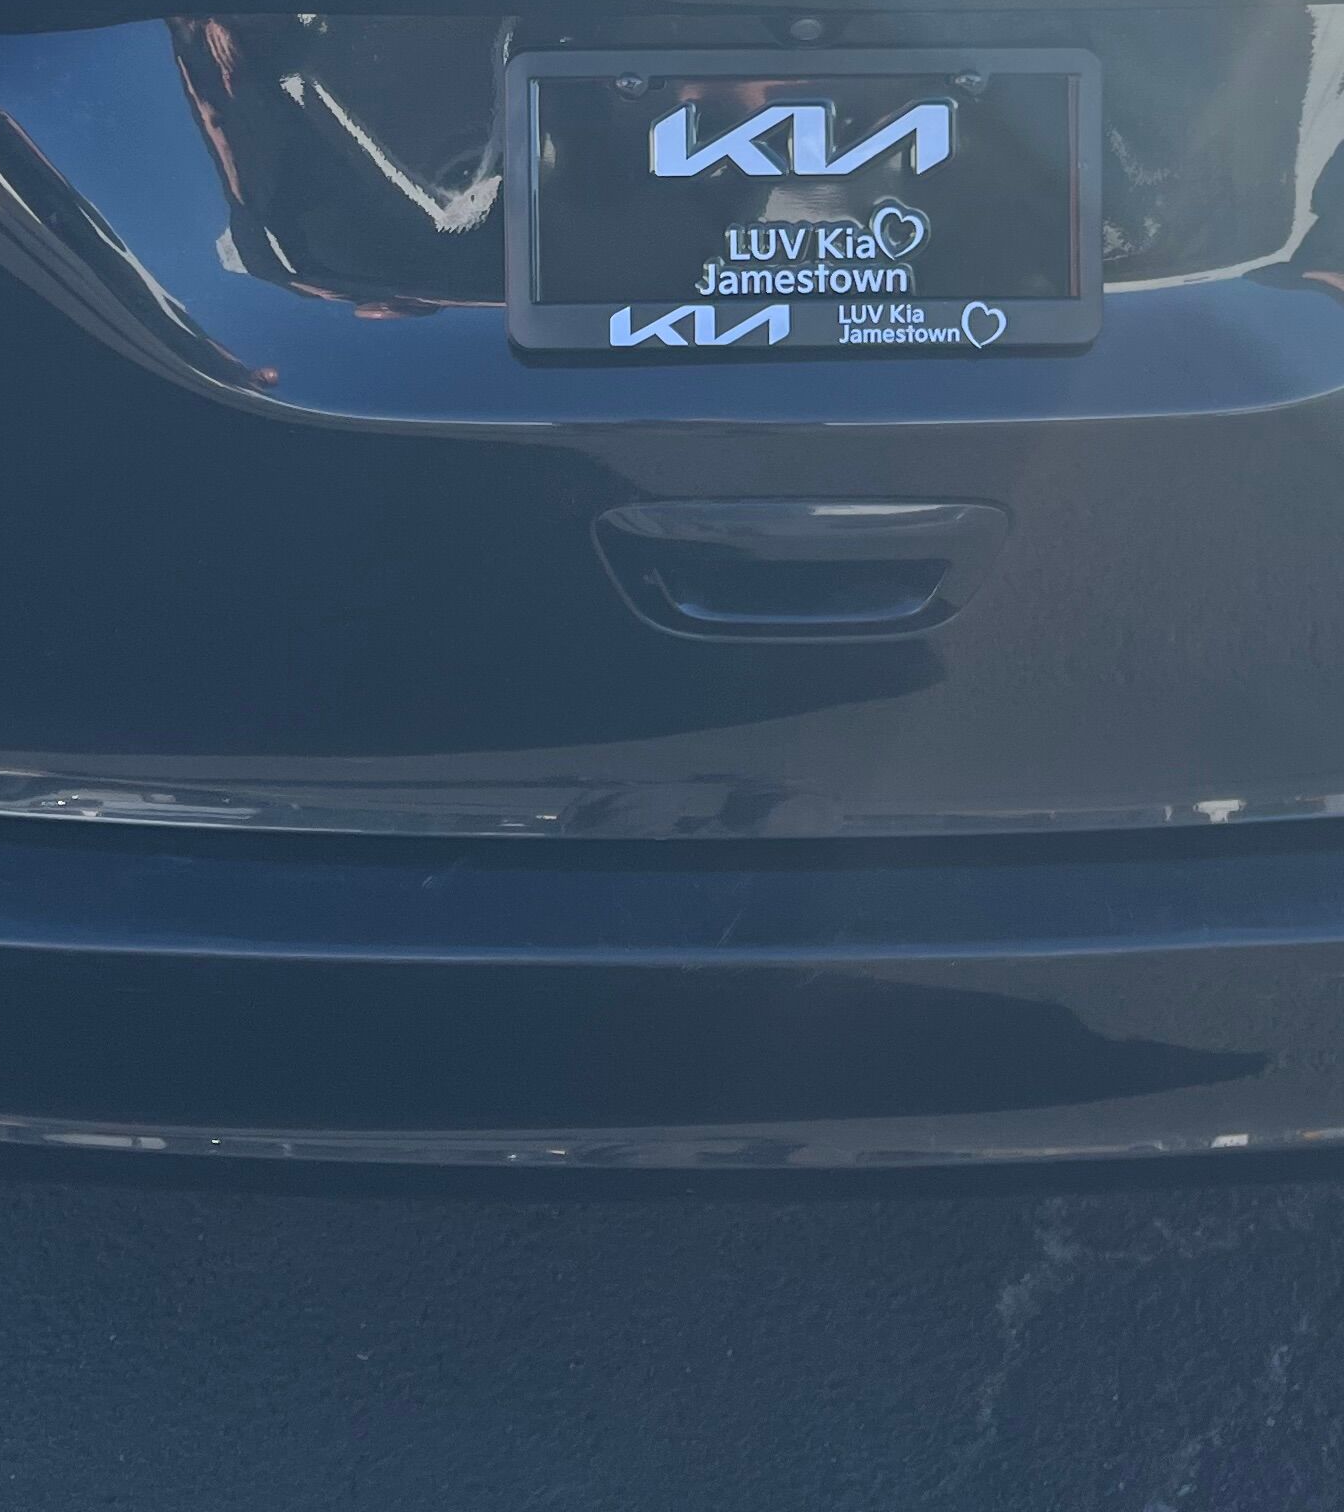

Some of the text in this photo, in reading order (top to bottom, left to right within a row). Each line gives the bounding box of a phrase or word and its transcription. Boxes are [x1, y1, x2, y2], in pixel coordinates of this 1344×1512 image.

[653, 103, 951, 177] KIA
[728, 226, 877, 261] LUV Kia
[698, 264, 908, 295] Jamestown
[609, 304, 790, 346] KIA
[838, 304, 925, 324] LUV Kia
[838, 324, 960, 345] Jamestown
